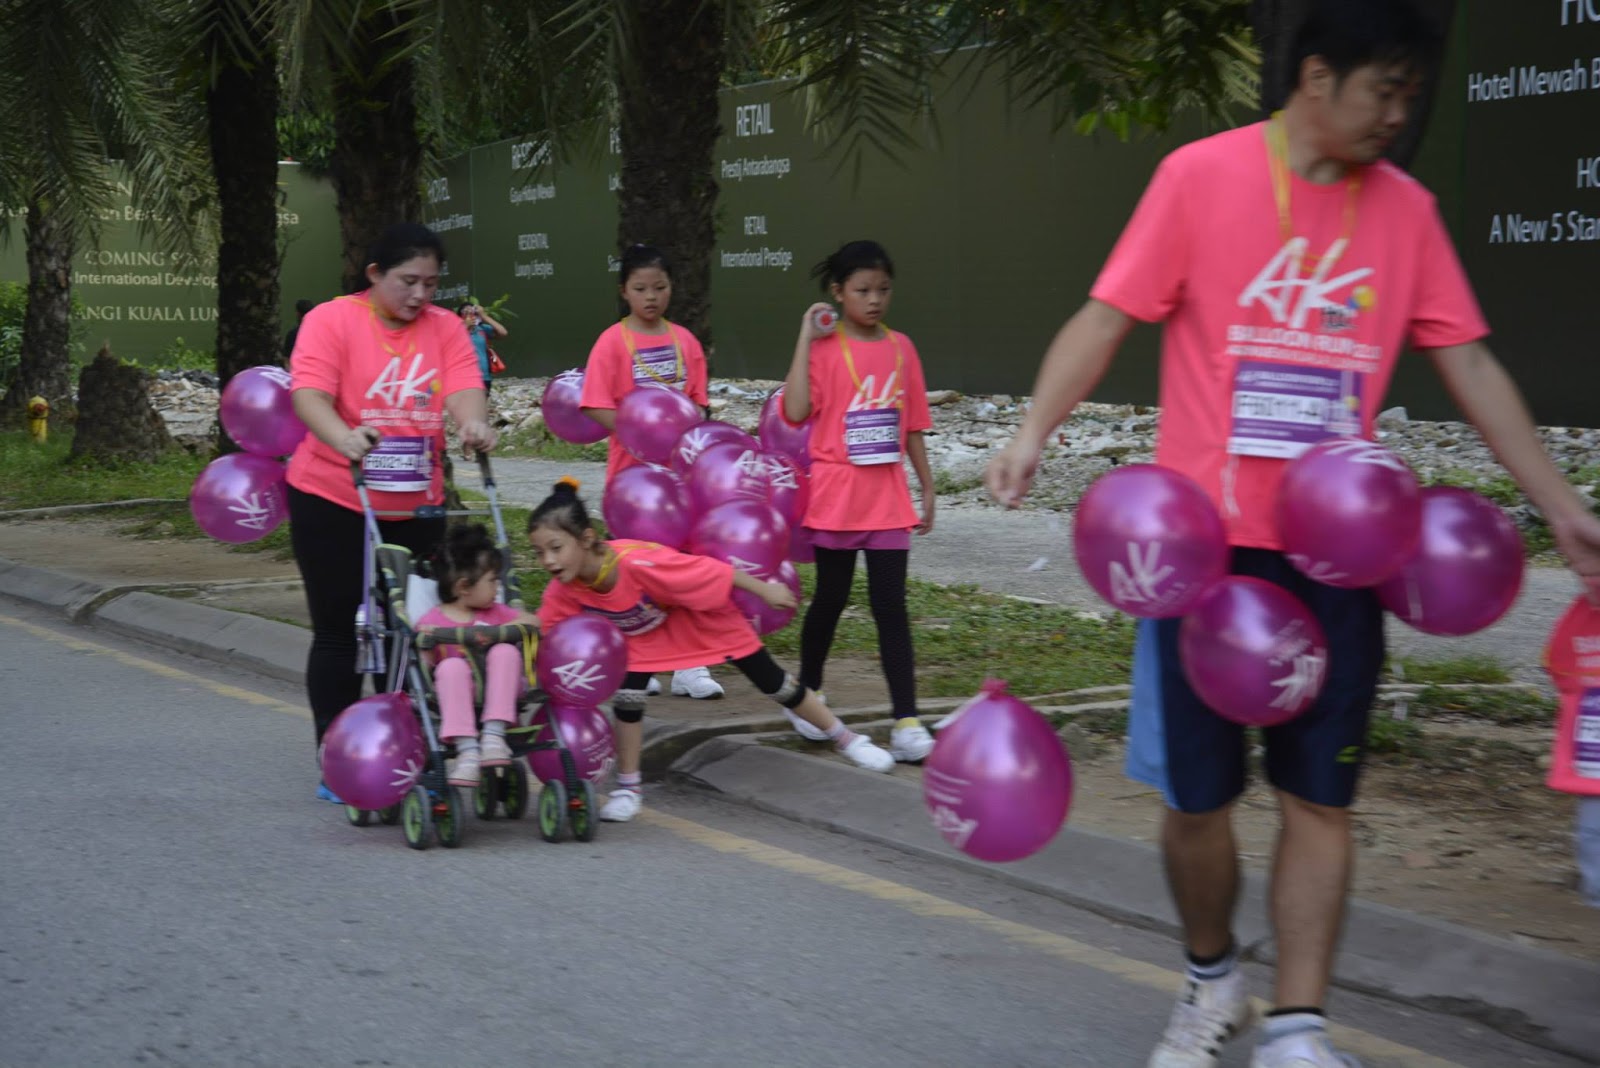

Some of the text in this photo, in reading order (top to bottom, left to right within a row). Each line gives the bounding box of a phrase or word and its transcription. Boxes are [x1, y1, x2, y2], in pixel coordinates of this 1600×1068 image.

[1468, 66, 1515, 102] Hotel
[1518, 58, 1587, 97] Mewah
[736, 103, 774, 137] RETAIL
[744, 215, 768, 235] RETAIL
[1489, 215, 1503, 243] A
[1506, 214, 1548, 243] New
[1550, 212, 1563, 242] 5
[85, 250, 164, 266] COMING
[721, 248, 763, 268] International
[74, 270, 162, 285] International
[128, 306, 185, 321] KUALA
[365, 353, 438, 408] AK
[551, 660, 607, 691] AK
